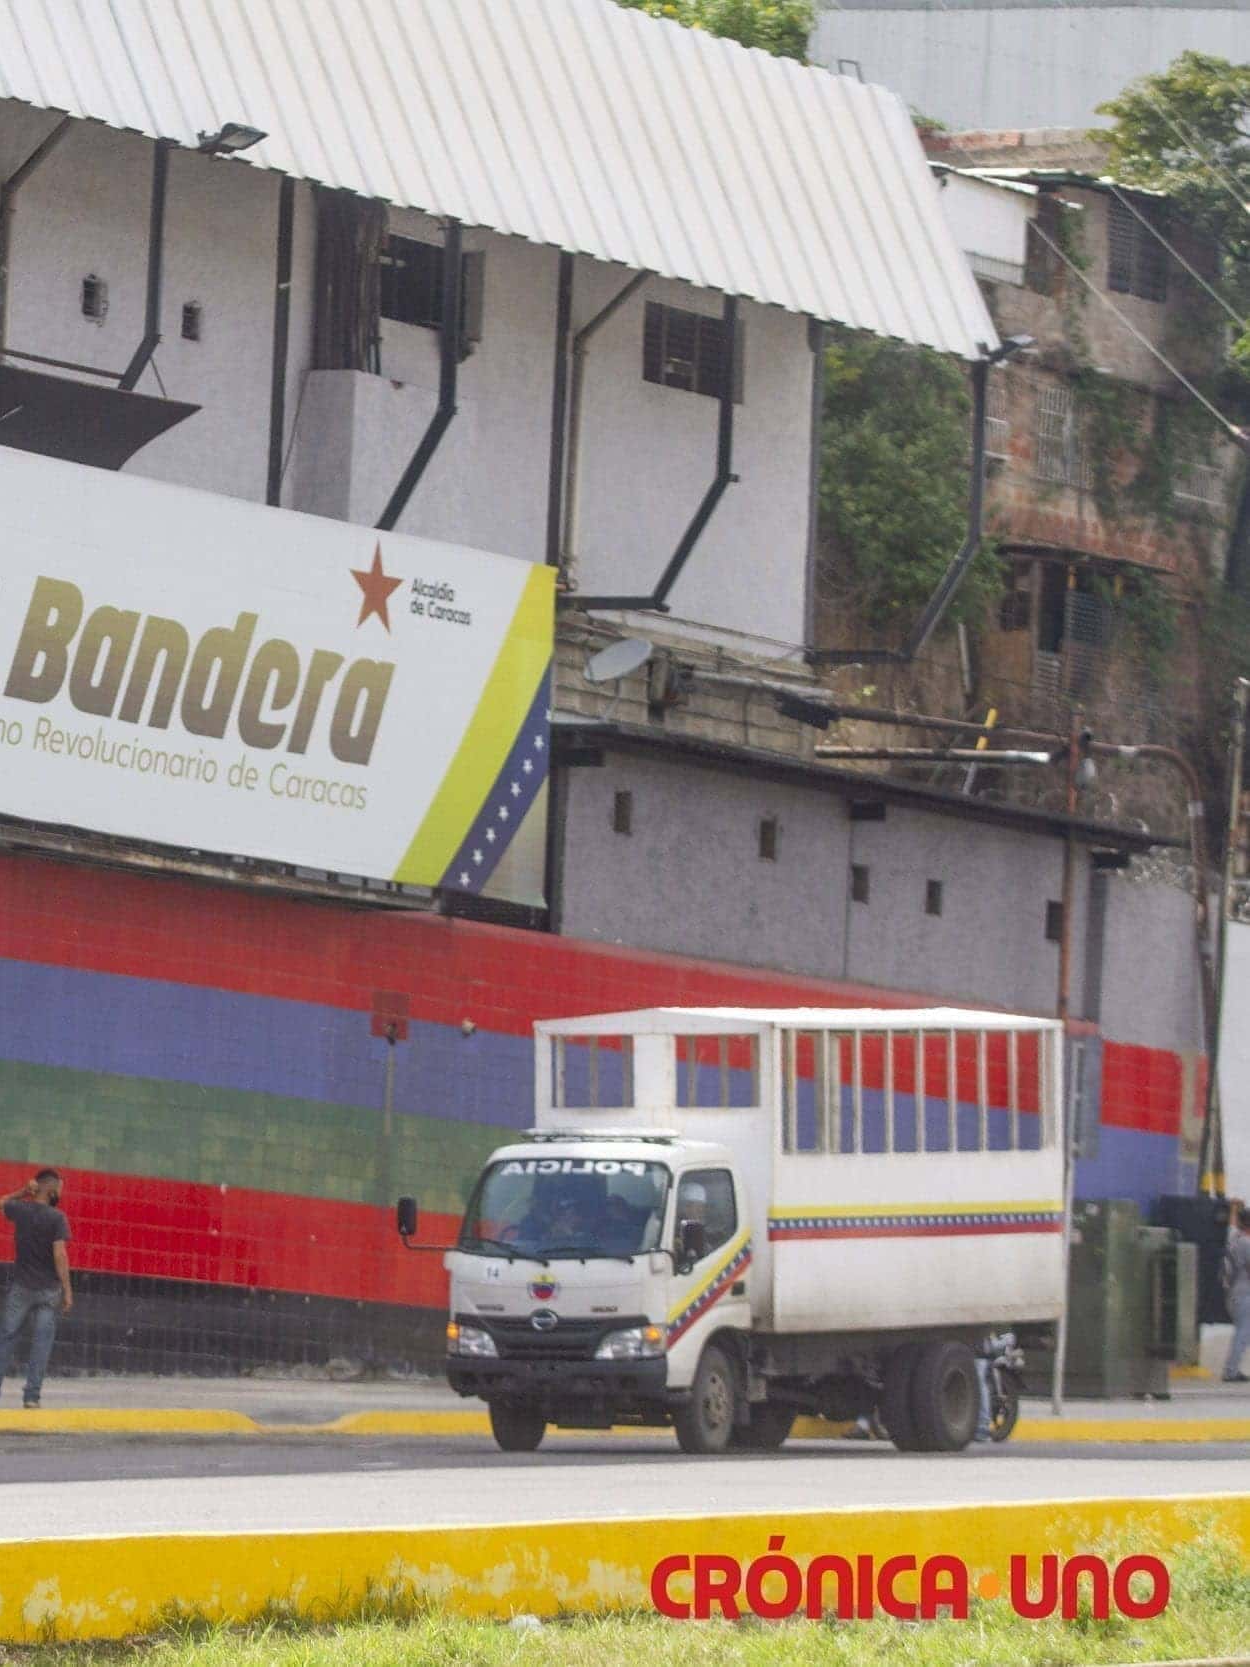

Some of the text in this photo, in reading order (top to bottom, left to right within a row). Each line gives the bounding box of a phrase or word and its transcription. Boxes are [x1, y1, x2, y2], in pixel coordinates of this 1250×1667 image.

[410, 598, 472, 625] de Caracas
[411, 578, 456, 603] Alcaldía
[3, 575, 397, 766] Bandera
[33, 716, 218, 784] Revolucionario
[227, 753, 259, 790] de
[269, 762, 368, 810] Caracas
